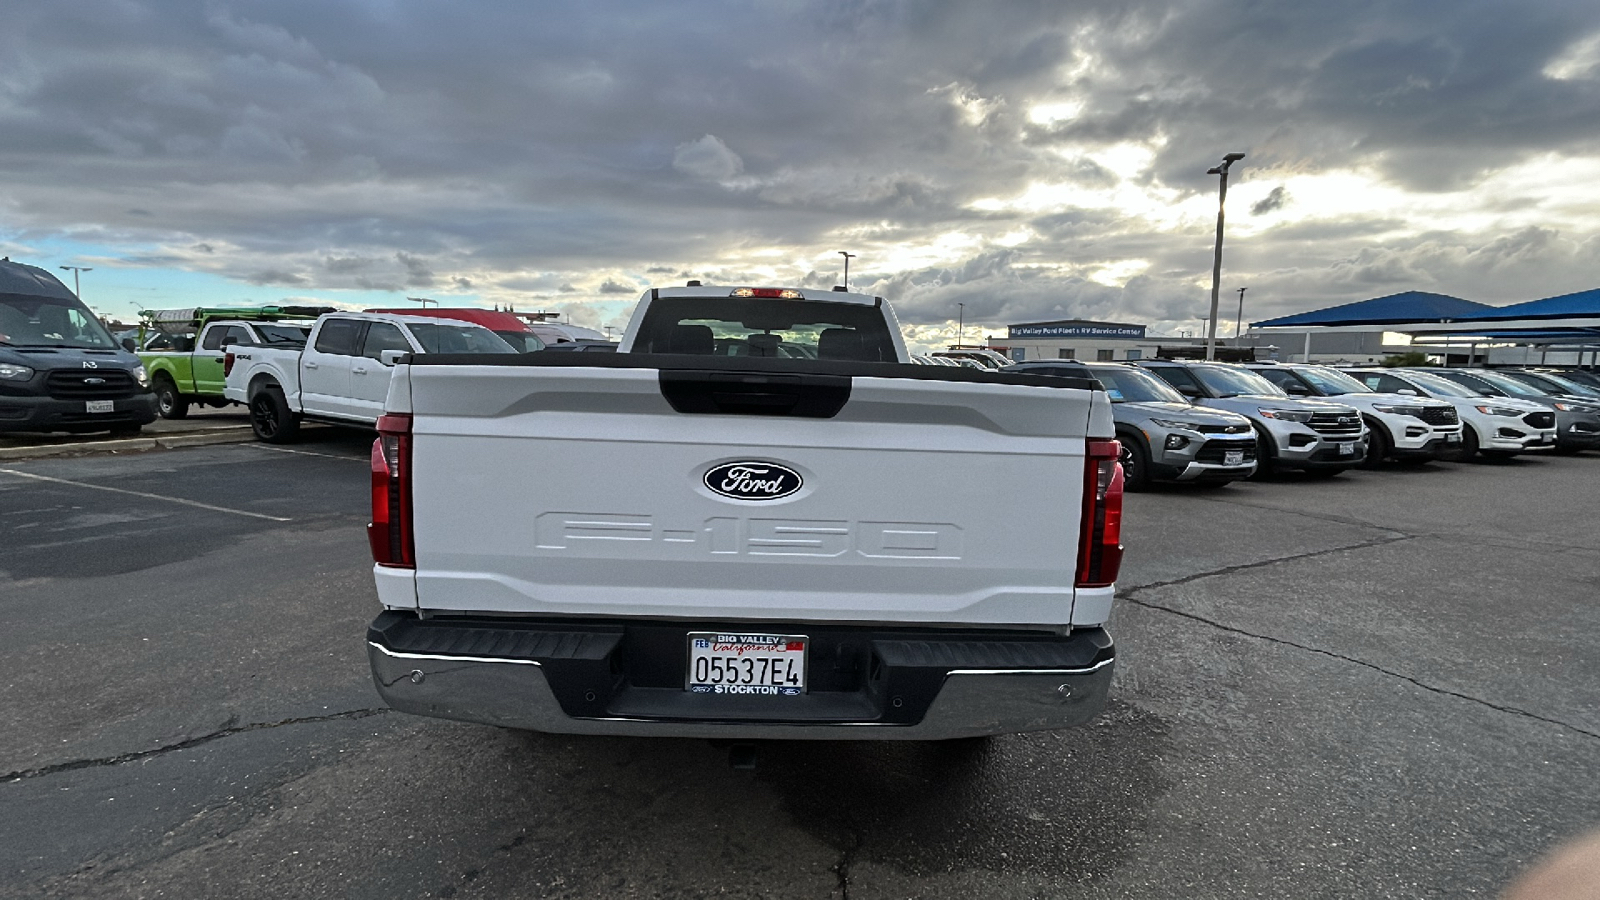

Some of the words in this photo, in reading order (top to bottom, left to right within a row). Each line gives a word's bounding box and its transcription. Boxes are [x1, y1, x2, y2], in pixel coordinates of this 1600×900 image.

[1011, 327, 1022, 335] Big
[1022, 327, 1042, 335] Valley
[82, 361, 98, 369] A3
[721, 466, 785, 494] Ford
[534, 511, 965, 560] F-150
[695, 639, 709, 648] FEB
[717, 635, 737, 643] BIG
[739, 636, 780, 644] VALLEY
[696, 657, 799, 685] 05537E4
[714, 685, 778, 695] STOCKTON
